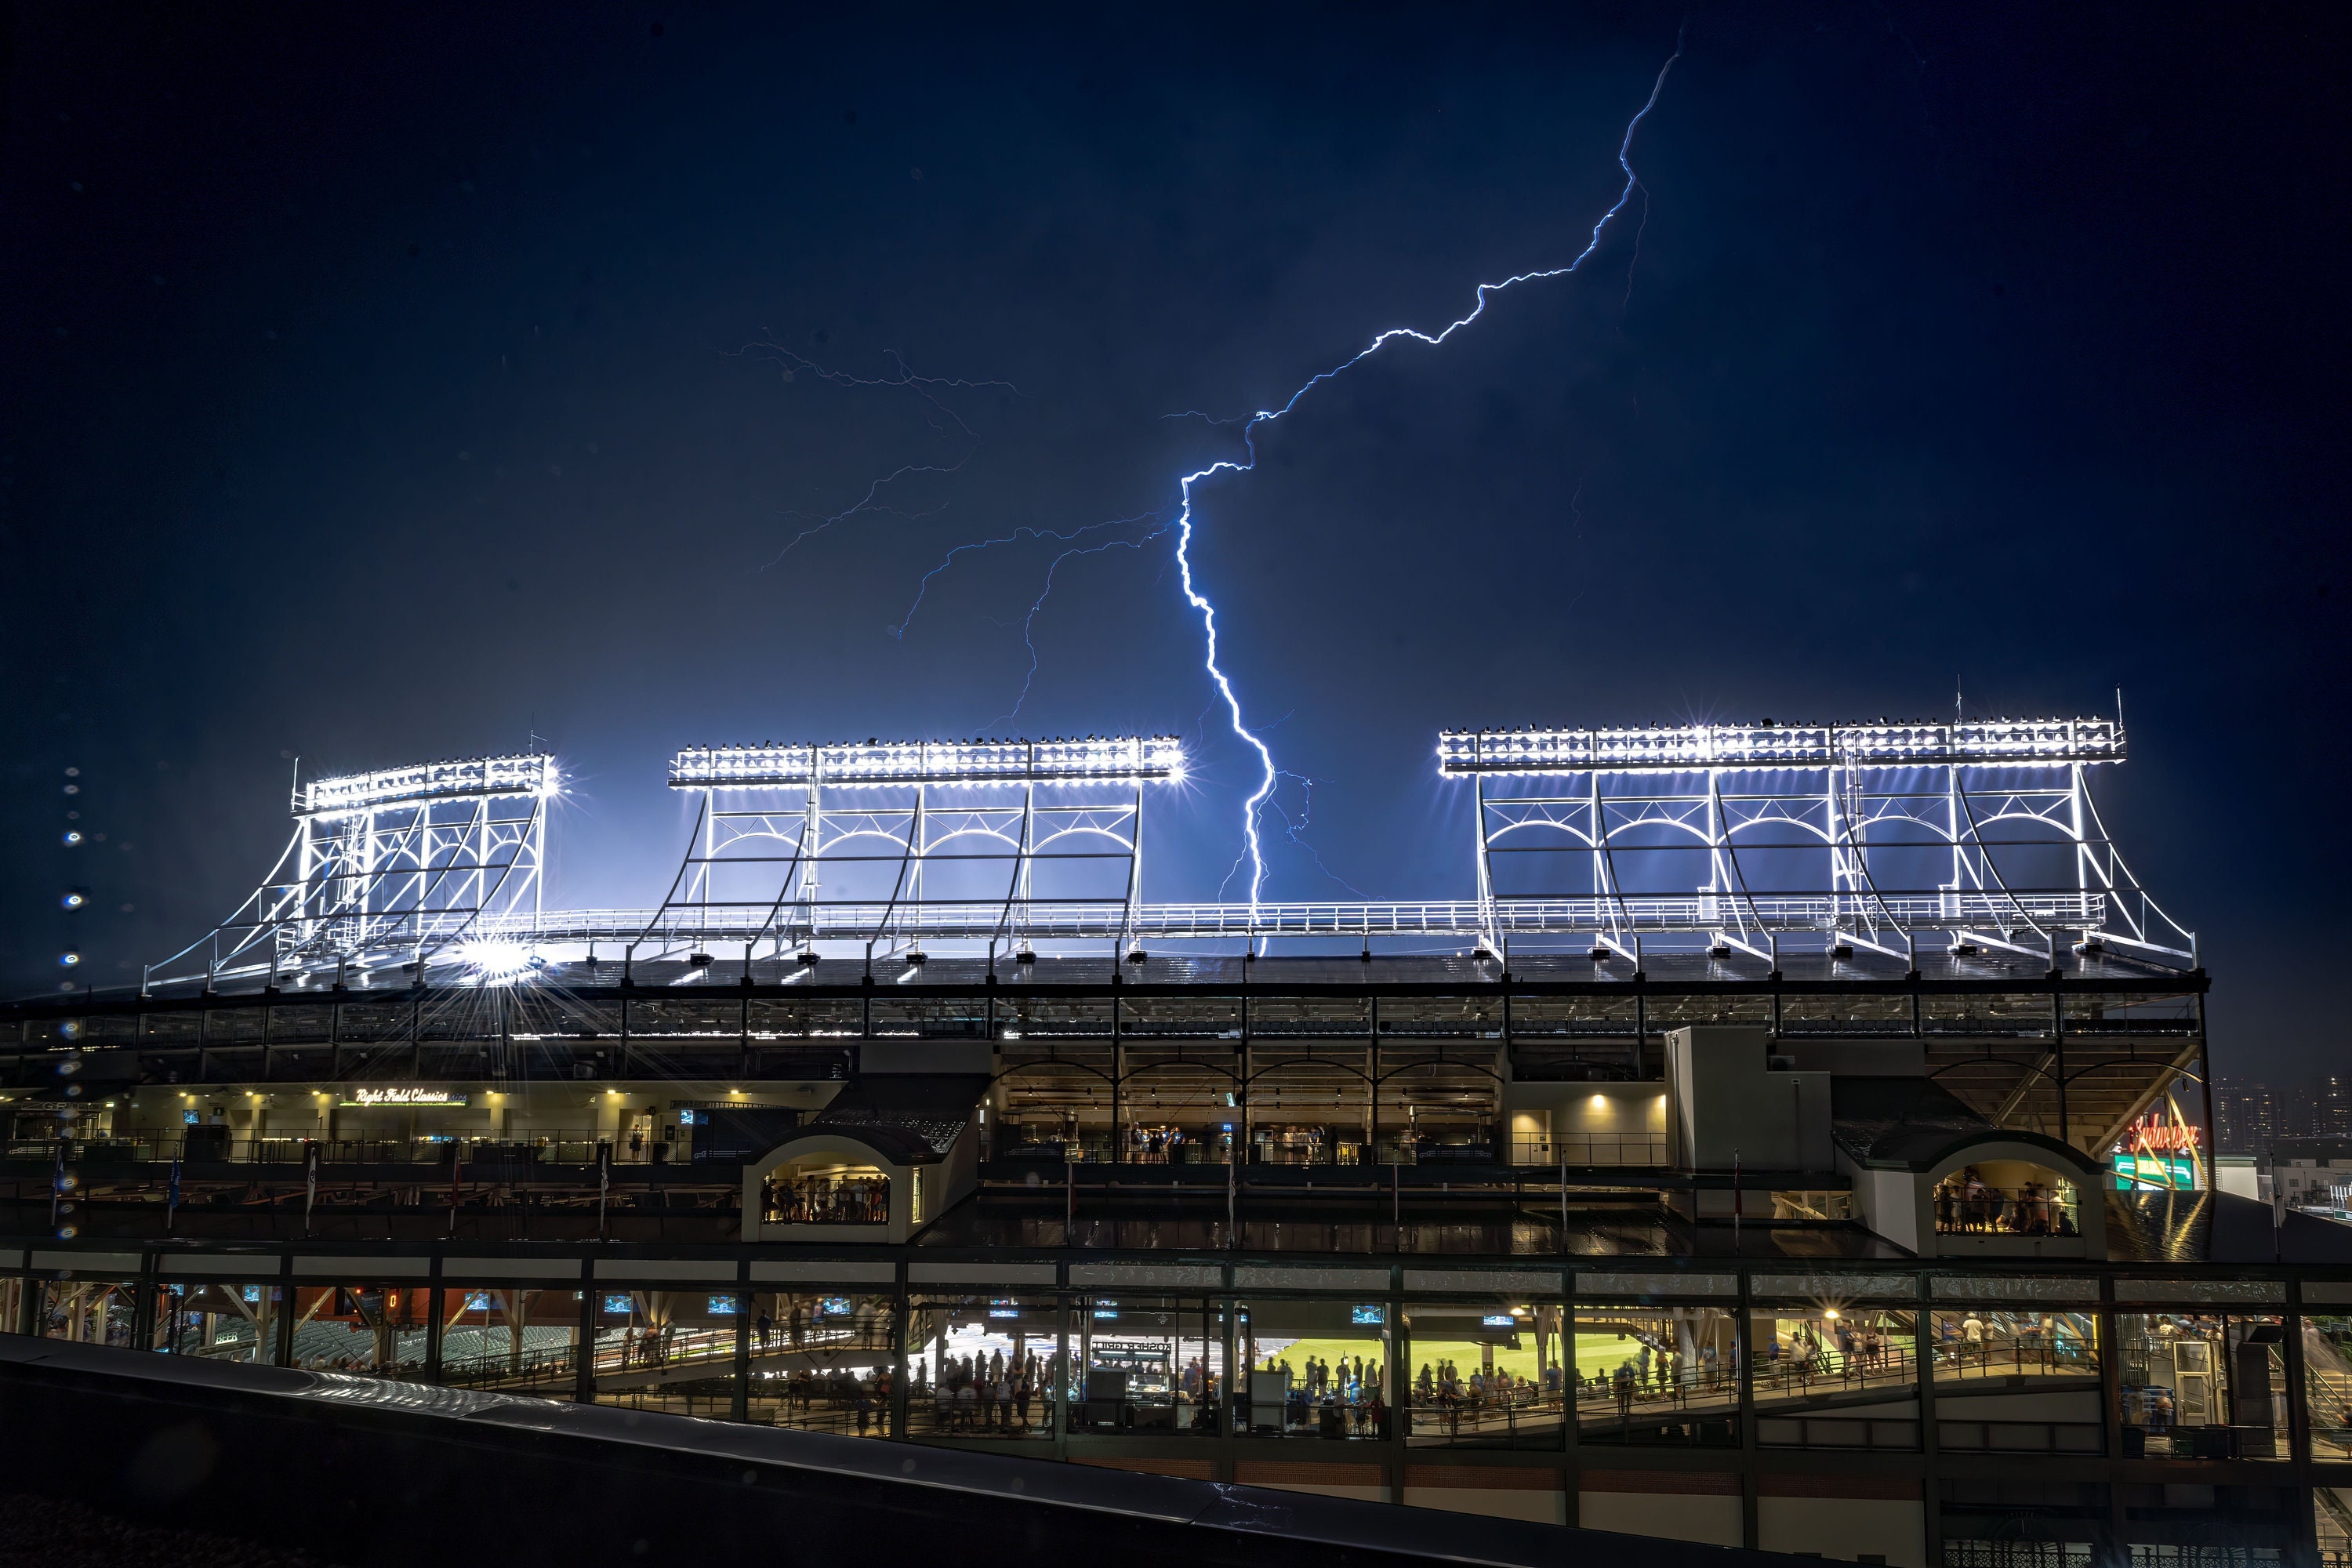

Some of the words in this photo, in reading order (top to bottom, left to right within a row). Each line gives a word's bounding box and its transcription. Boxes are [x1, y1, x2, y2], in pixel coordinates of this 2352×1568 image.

[357, 1088, 383, 1107] Right
[384, 1088, 412, 1102] Field
[412, 1088, 448, 1102] Classics
[216, 1332, 238, 1343] BEER
